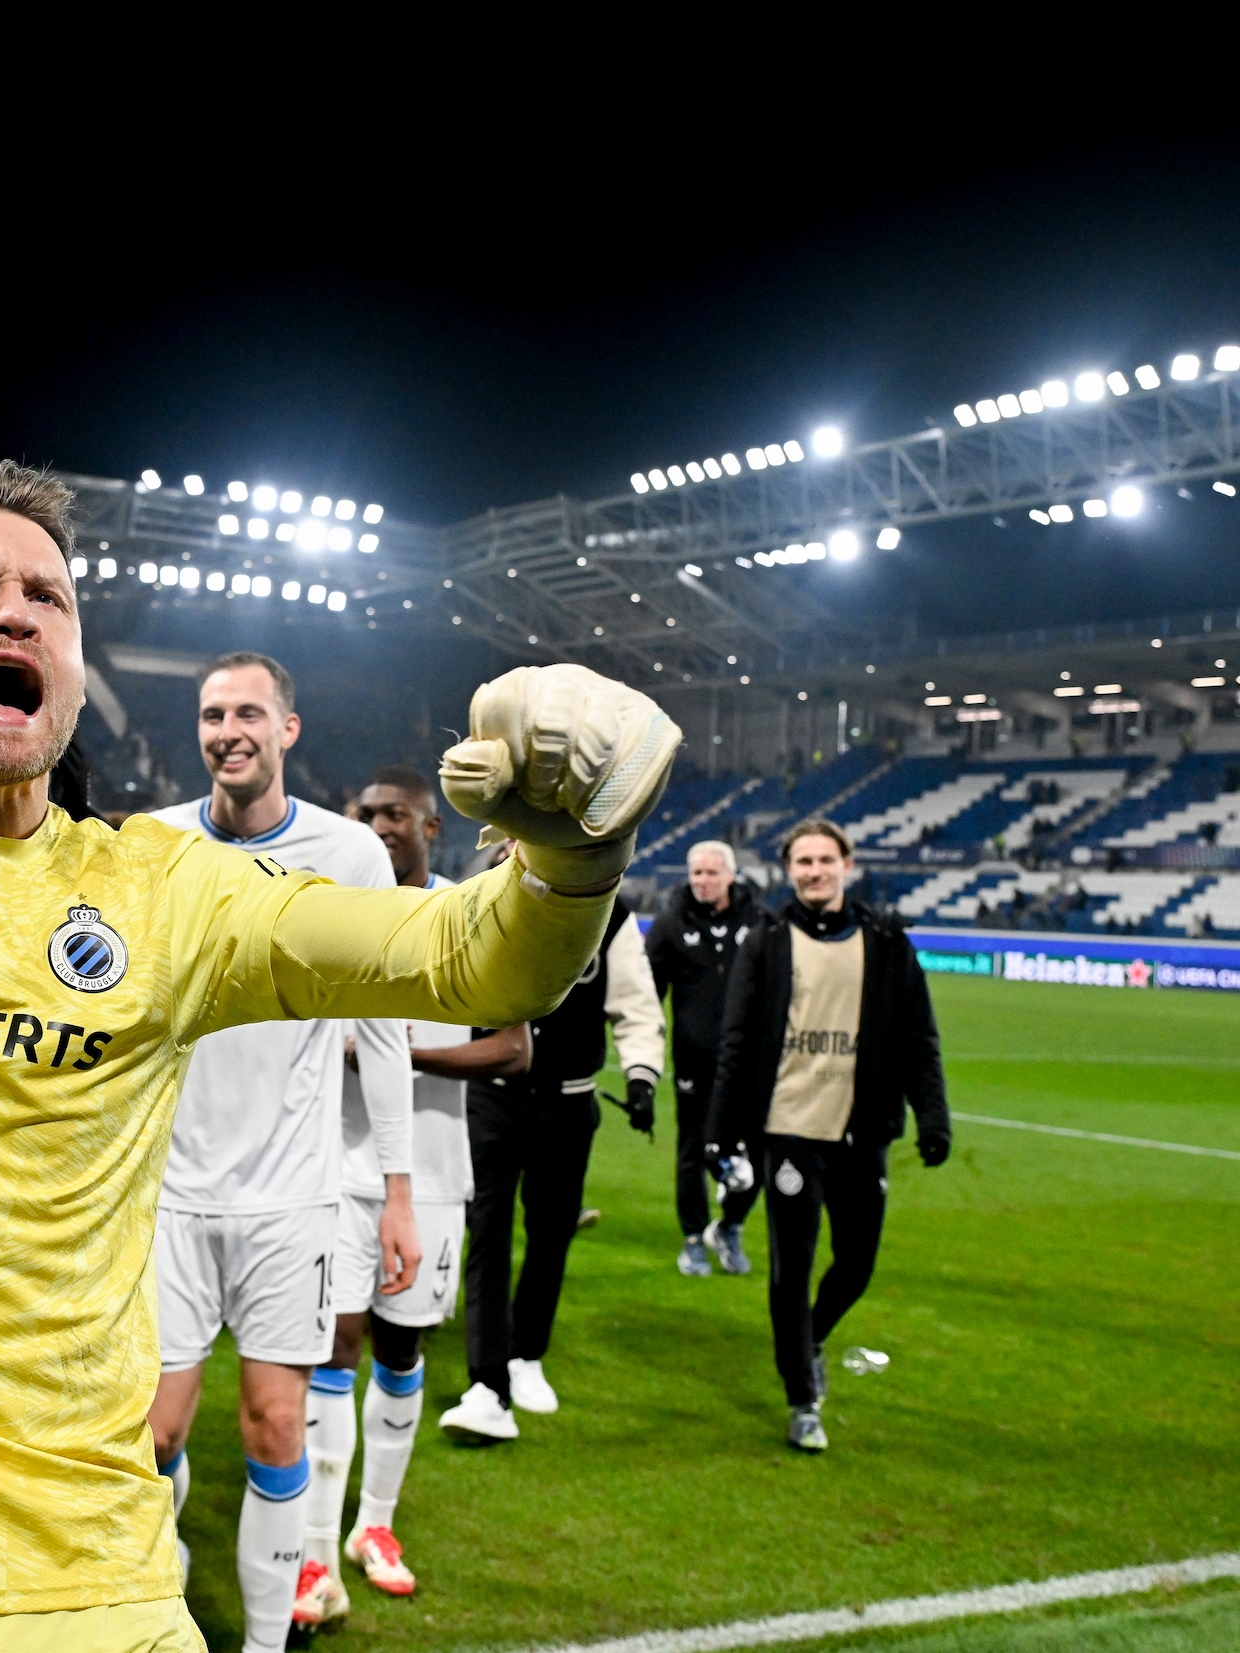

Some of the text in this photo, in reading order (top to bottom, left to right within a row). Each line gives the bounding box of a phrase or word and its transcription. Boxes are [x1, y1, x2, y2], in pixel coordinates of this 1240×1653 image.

[56, 963, 122, 988] CLUB BRUGGE KV
[1003, 951, 1125, 988] Heineken
